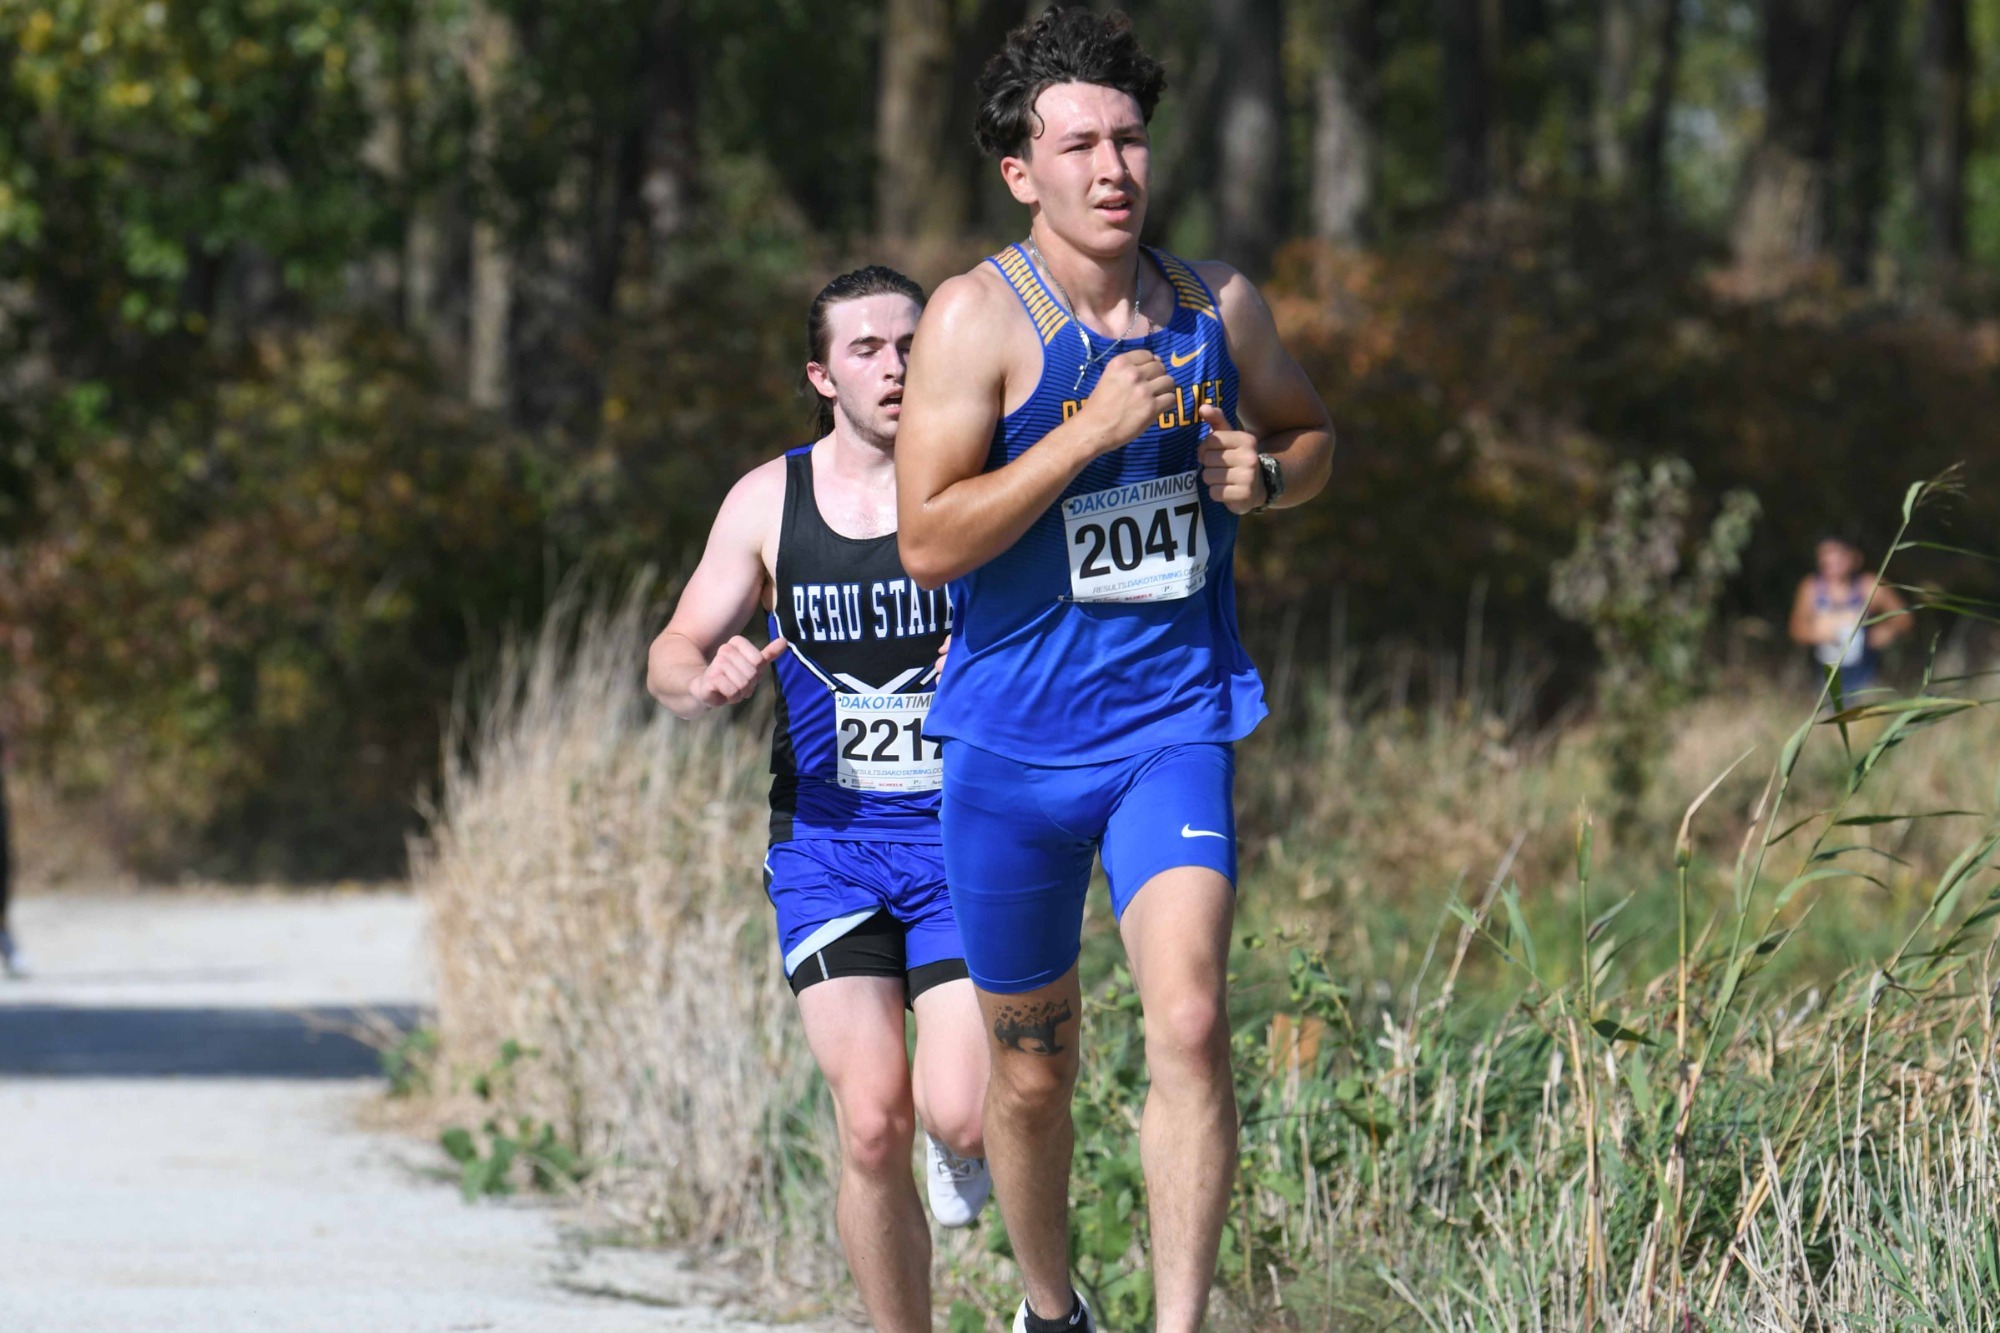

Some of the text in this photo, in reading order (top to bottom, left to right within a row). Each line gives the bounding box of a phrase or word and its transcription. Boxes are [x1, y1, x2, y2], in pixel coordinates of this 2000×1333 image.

[1072, 473, 1196, 515] DAKOTATIMING
[1074, 501, 1200, 579] 2047
[792, 584, 862, 641] PERU
